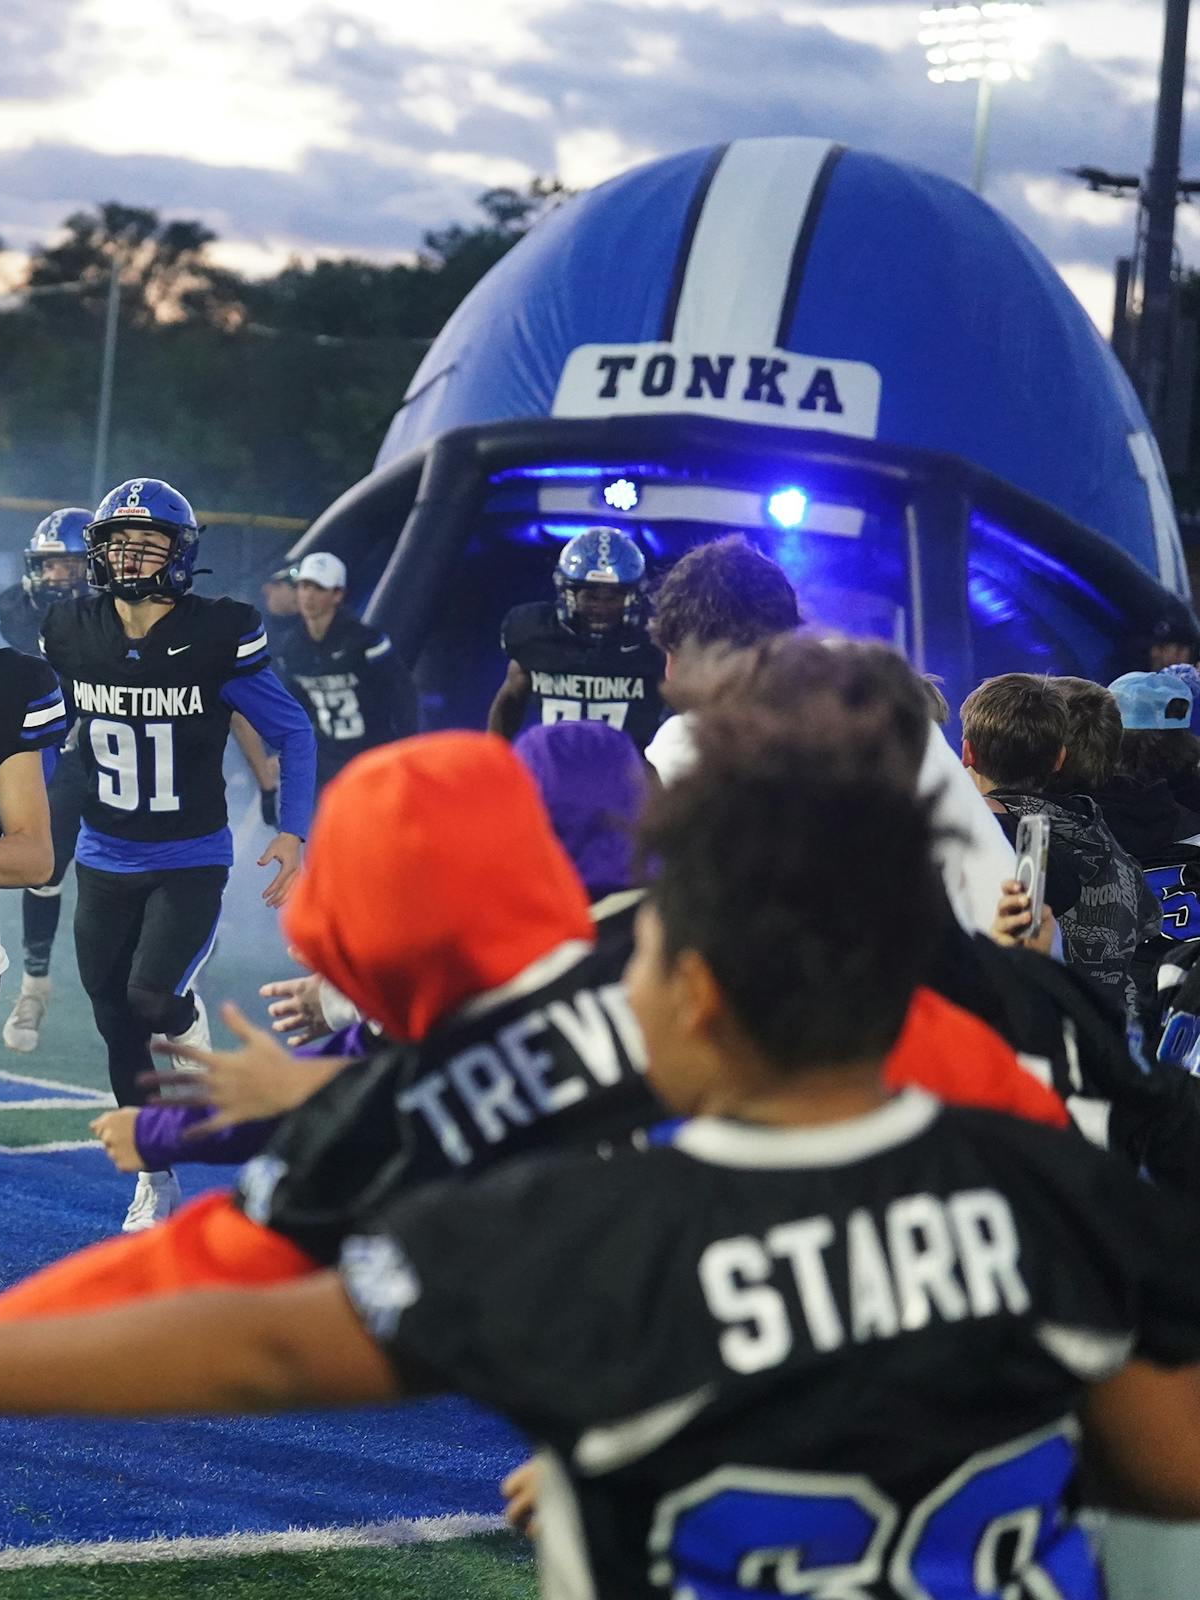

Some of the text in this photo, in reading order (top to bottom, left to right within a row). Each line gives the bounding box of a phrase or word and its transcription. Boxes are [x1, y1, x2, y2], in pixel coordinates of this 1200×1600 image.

[596, 352, 844, 415] TONKA
[72, 679, 204, 717] MINNETONKA
[531, 670, 646, 700] MINNETONKA
[89, 718, 181, 812] 91
[698, 1188, 1032, 1374] STARR
